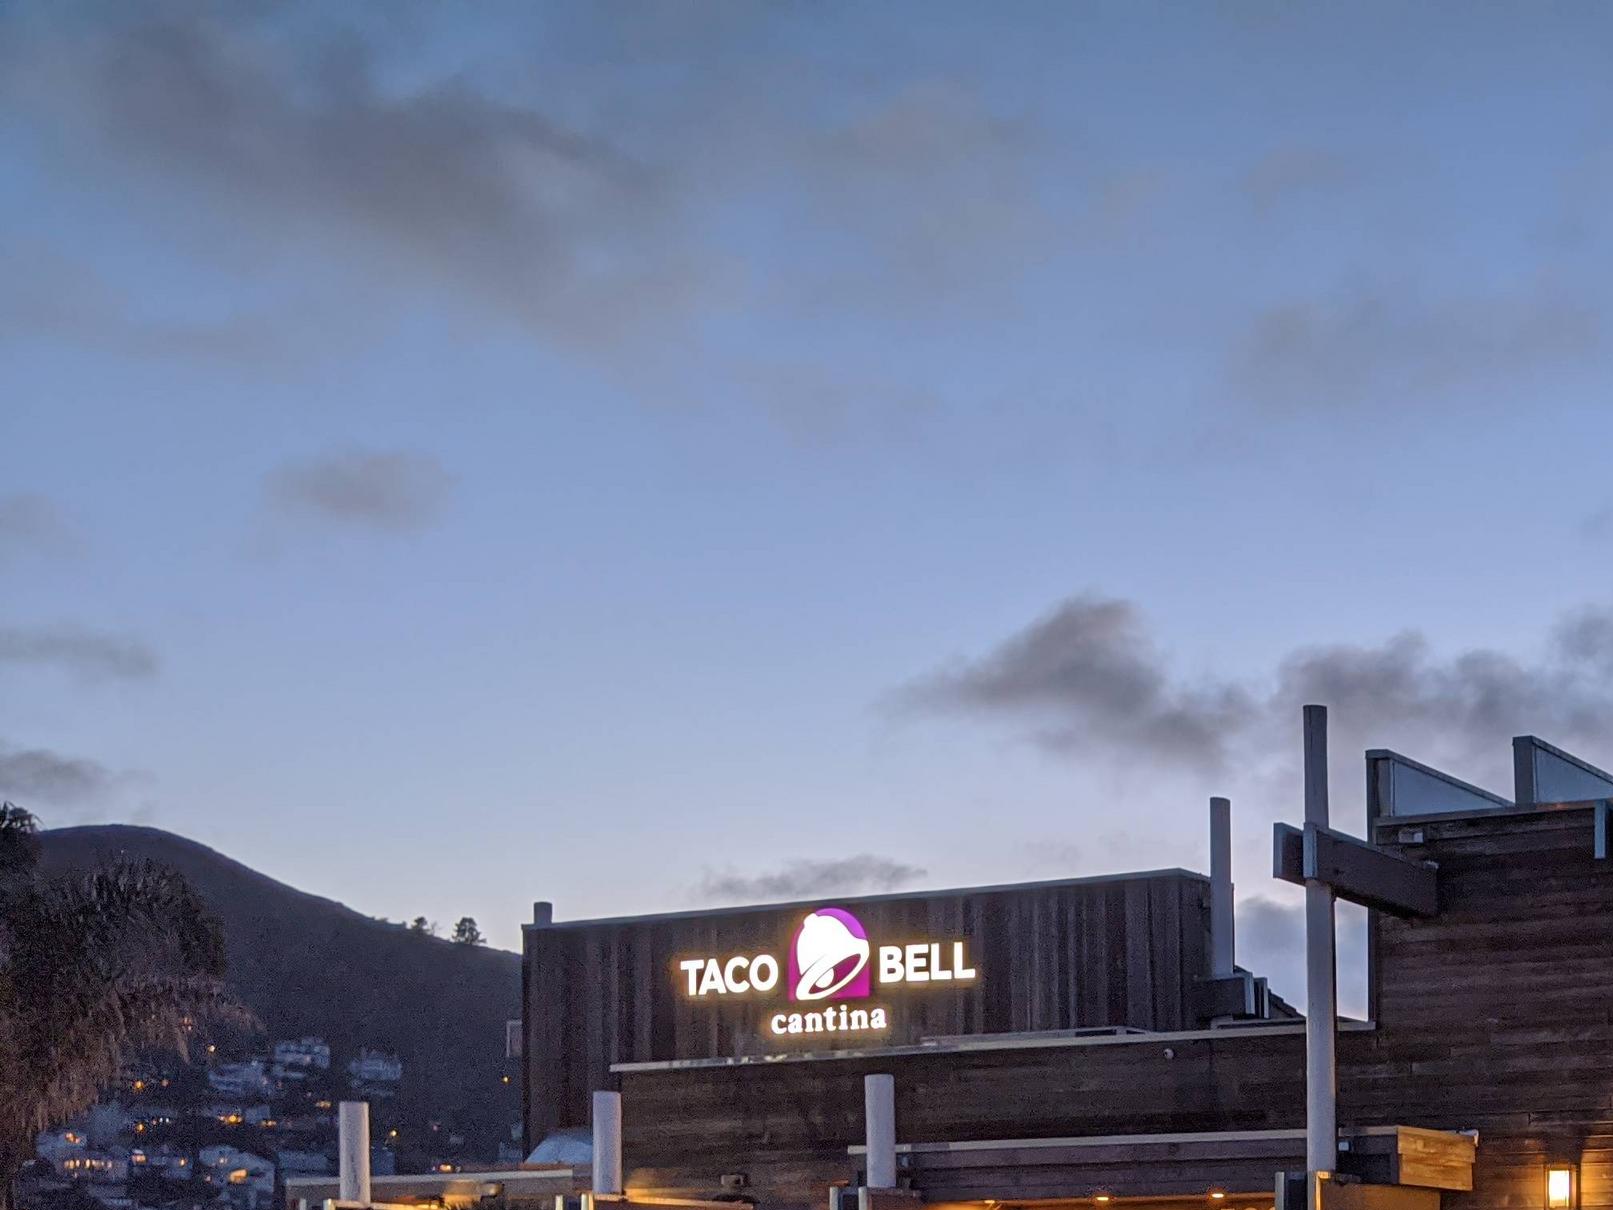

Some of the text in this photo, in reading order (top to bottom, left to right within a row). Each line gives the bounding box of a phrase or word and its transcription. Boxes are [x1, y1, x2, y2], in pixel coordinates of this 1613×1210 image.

[680, 941, 976, 996] TACO BELL
[770, 1004, 887, 1034] cantina
